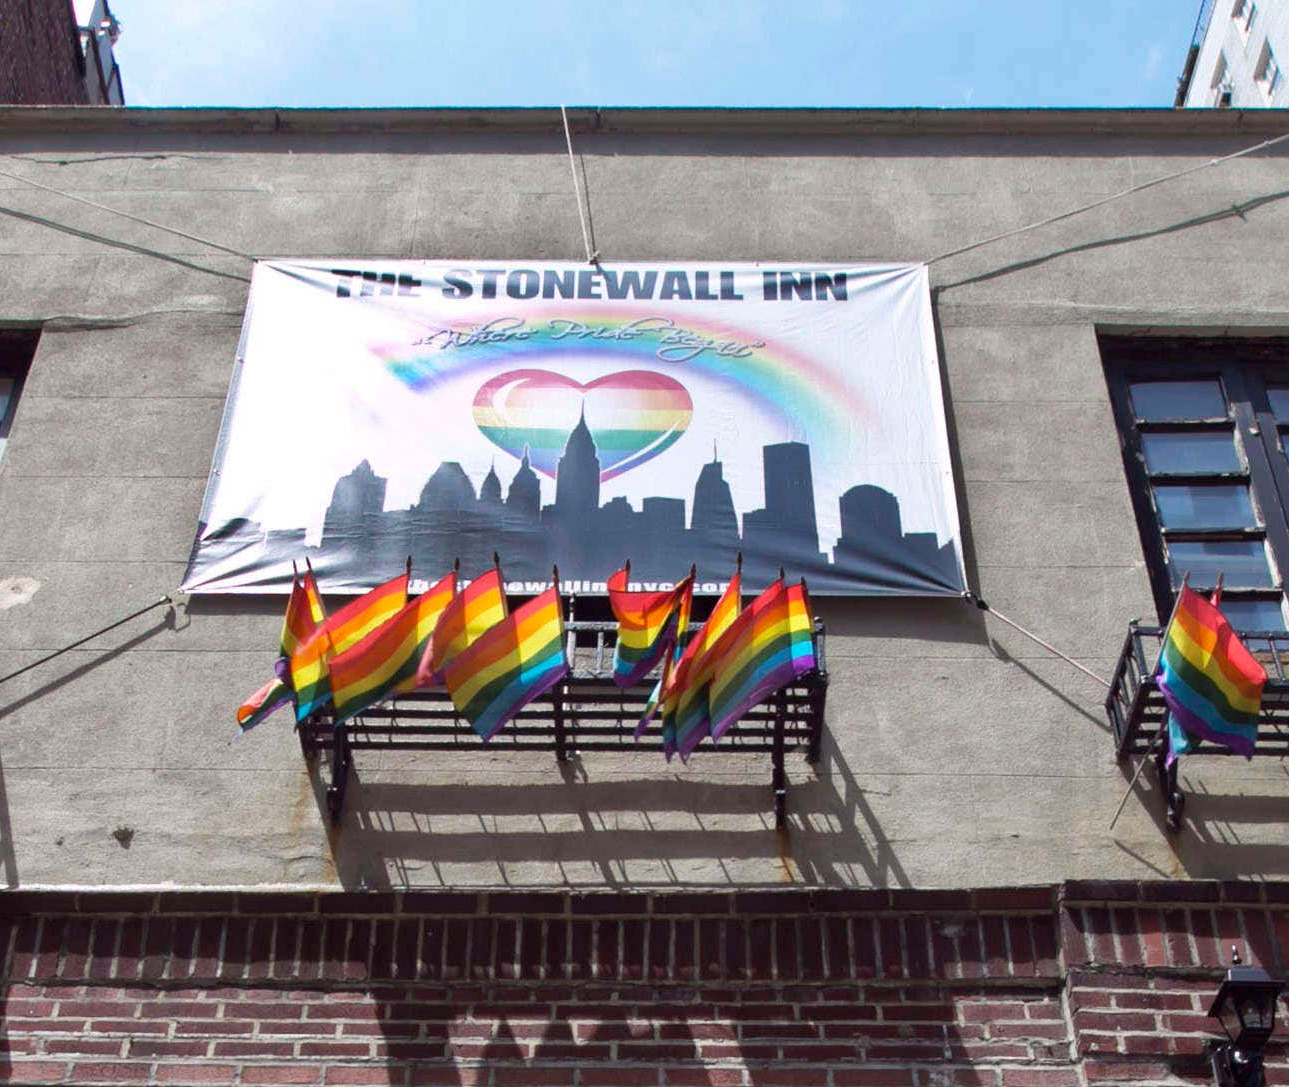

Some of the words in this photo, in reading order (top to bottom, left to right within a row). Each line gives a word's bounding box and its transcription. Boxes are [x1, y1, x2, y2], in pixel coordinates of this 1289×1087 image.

[331, 268, 422, 298] THE
[442, 269, 744, 300] STONEWALL
[762, 271, 848, 301] INN
